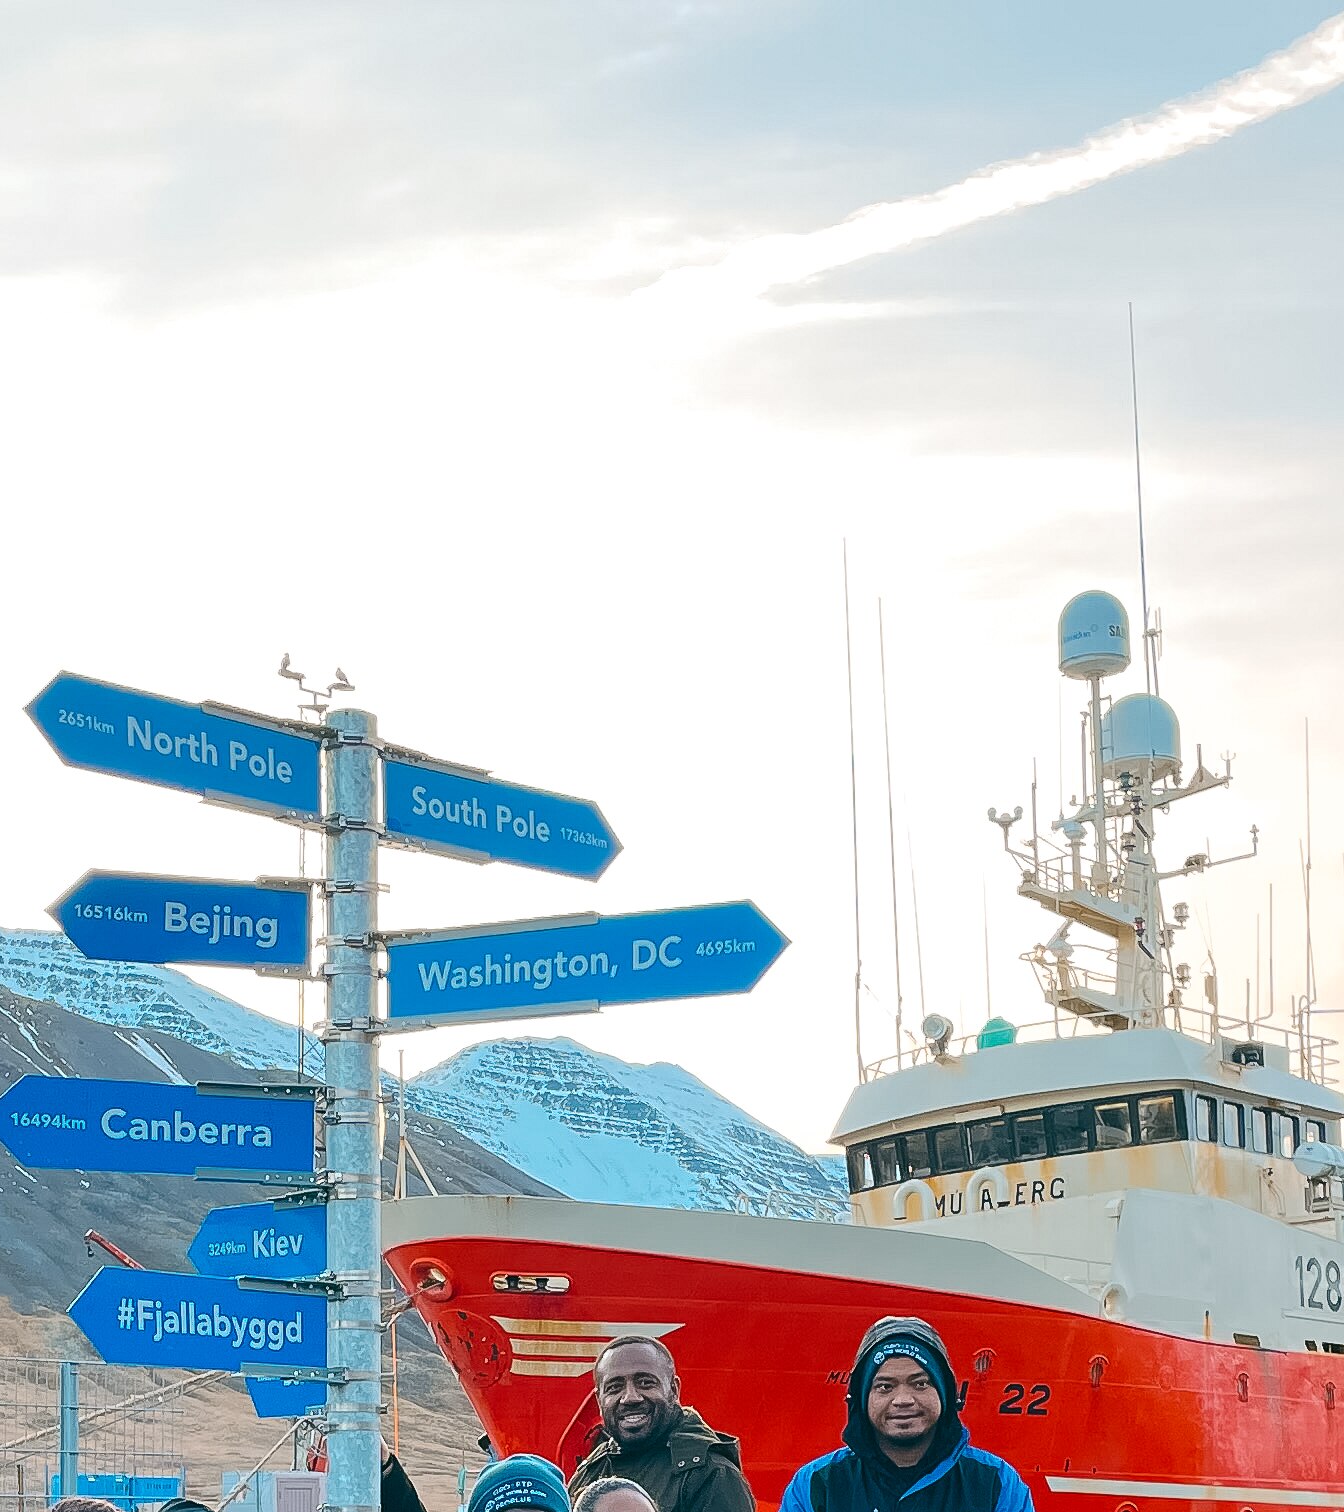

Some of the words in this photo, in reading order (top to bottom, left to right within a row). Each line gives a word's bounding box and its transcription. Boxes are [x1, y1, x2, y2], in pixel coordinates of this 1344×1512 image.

[58, 709, 115, 735] 2651km
[127, 715, 218, 766] North
[229, 740, 293, 784] Pole
[412, 785, 487, 829] South
[496, 804, 551, 843] Pole
[74, 903, 148, 923] 16516km
[164, 901, 278, 948] Bejing
[418, 951, 618, 992] Washington,
[632, 935, 683, 971] DC
[695, 939, 756, 958] 4695km
[10, 1112, 86, 1131] 16494km
[100, 1108, 273, 1148] Canberra
[253, 1228, 303, 1259] Kiev
[117, 1298, 303, 1351] #Fjallabyggd
[999, 1383, 1051, 1416] 22
